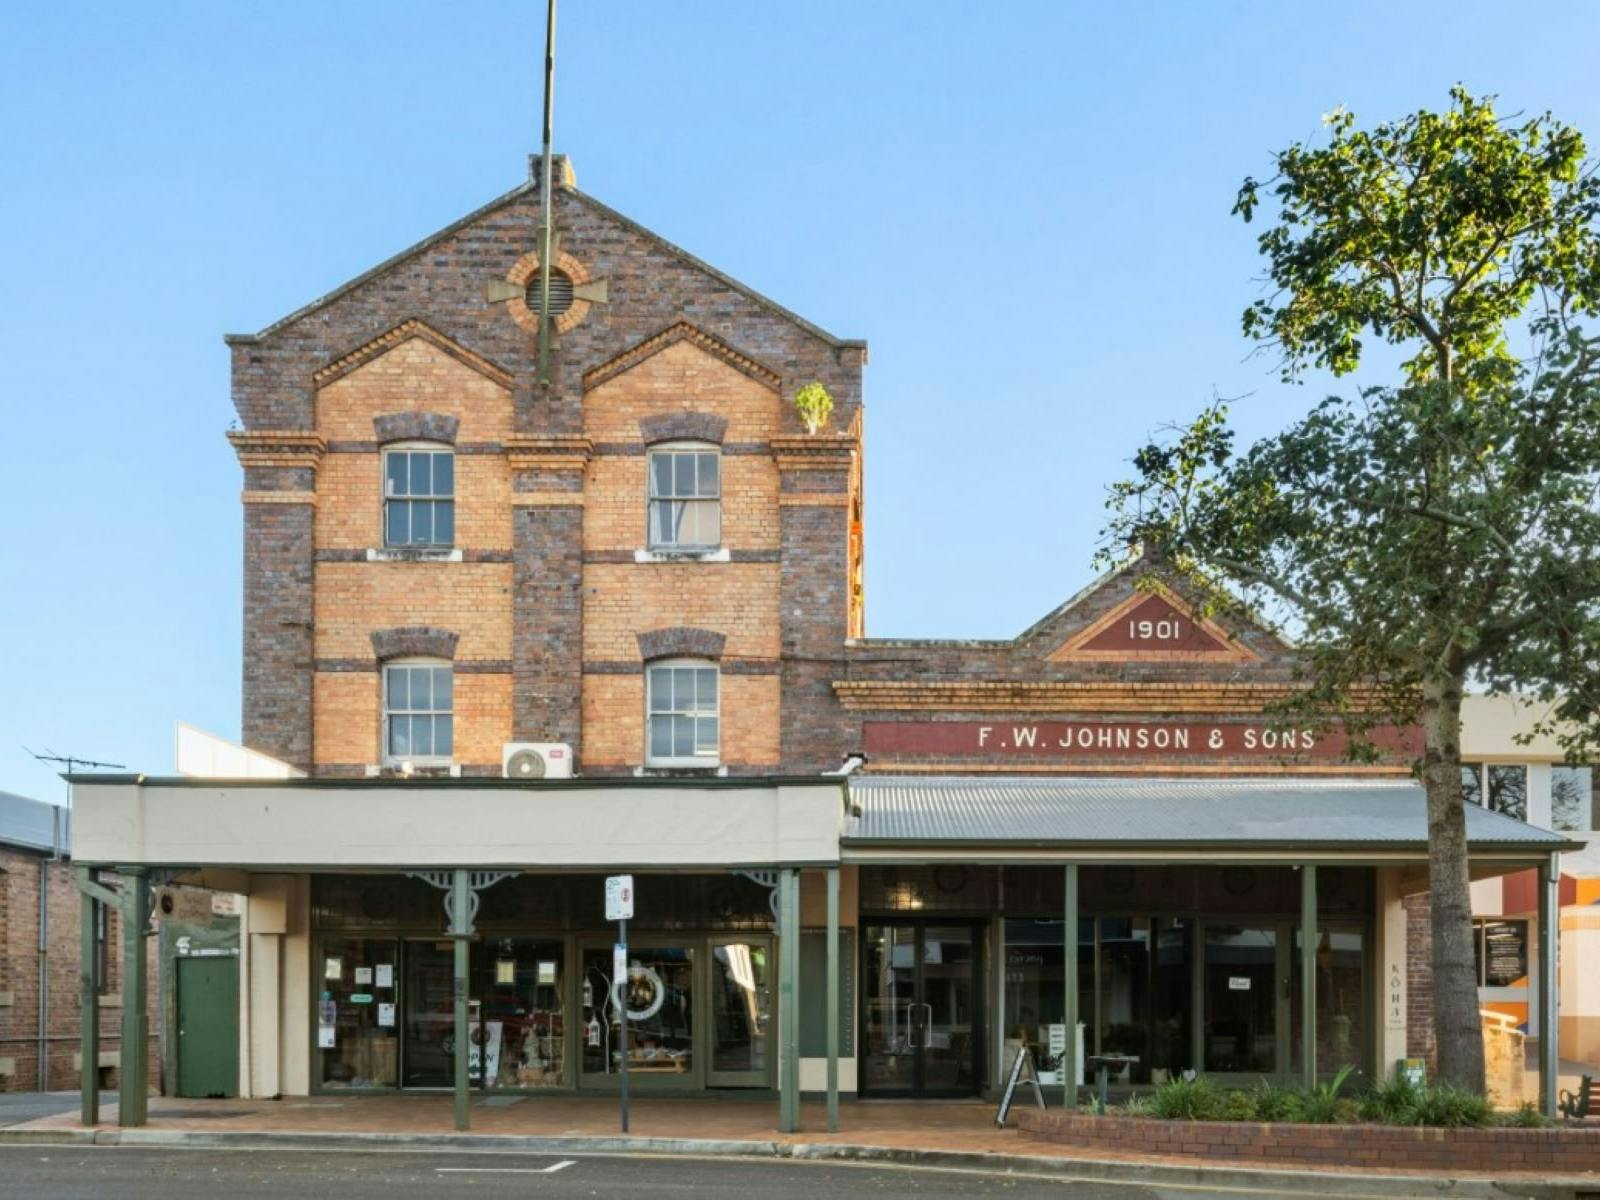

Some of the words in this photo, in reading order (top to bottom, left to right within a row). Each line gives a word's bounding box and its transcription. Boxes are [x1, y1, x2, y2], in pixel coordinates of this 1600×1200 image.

[1129, 620, 1179, 640] 1901
[1058, 727, 1189, 749] JOHNSON
[1208, 729, 1224, 749] &
[1244, 729, 1314, 749] SONS
